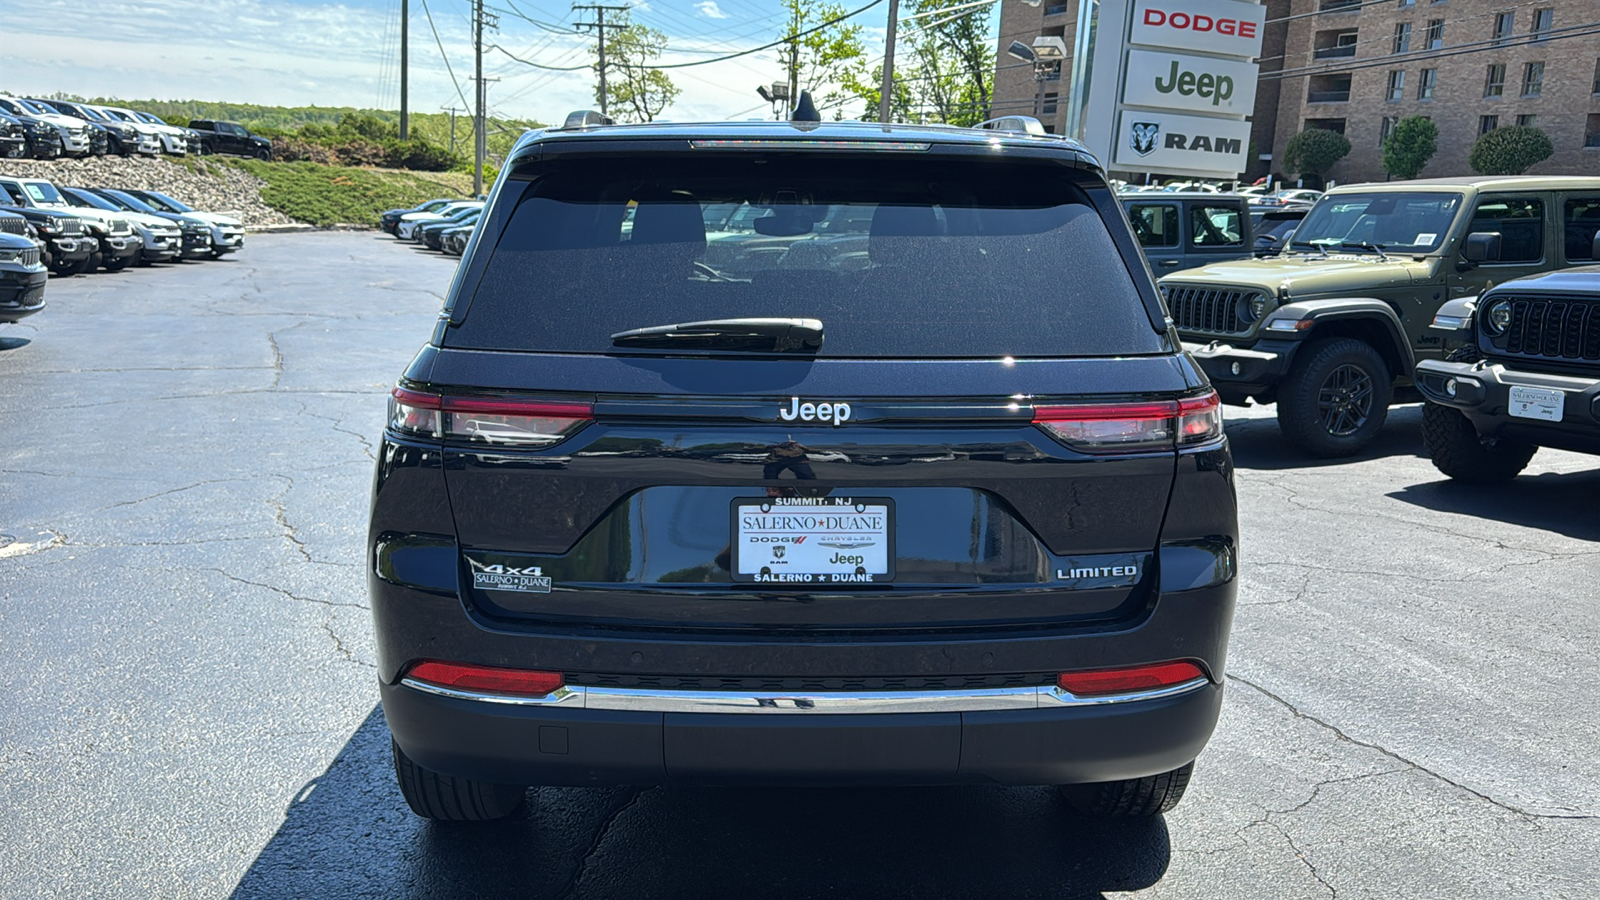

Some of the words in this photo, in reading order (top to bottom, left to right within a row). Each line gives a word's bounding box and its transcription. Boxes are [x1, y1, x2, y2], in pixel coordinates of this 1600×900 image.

[1143, 8, 1257, 38] DODGE
[1155, 60, 1234, 106] Jeep
[1164, 132, 1242, 154] RAM
[1417, 334, 1440, 345] Jeep
[780, 397, 851, 426] Jeep
[775, 497, 828, 506] SUMMIT,
[835, 497, 852, 506] NJ
[743, 516, 817, 530] SALERNO
[826, 516, 882, 530] DUANE
[829, 552, 864, 566] Jeep
[483, 564, 543, 577] 4x4
[1057, 565, 1137, 579] LIMITED
[476, 574, 513, 585] SALERNO
[520, 577, 549, 587] DUANE
[753, 574, 813, 582] SALERNO
[832, 574, 873, 582] DUANE
